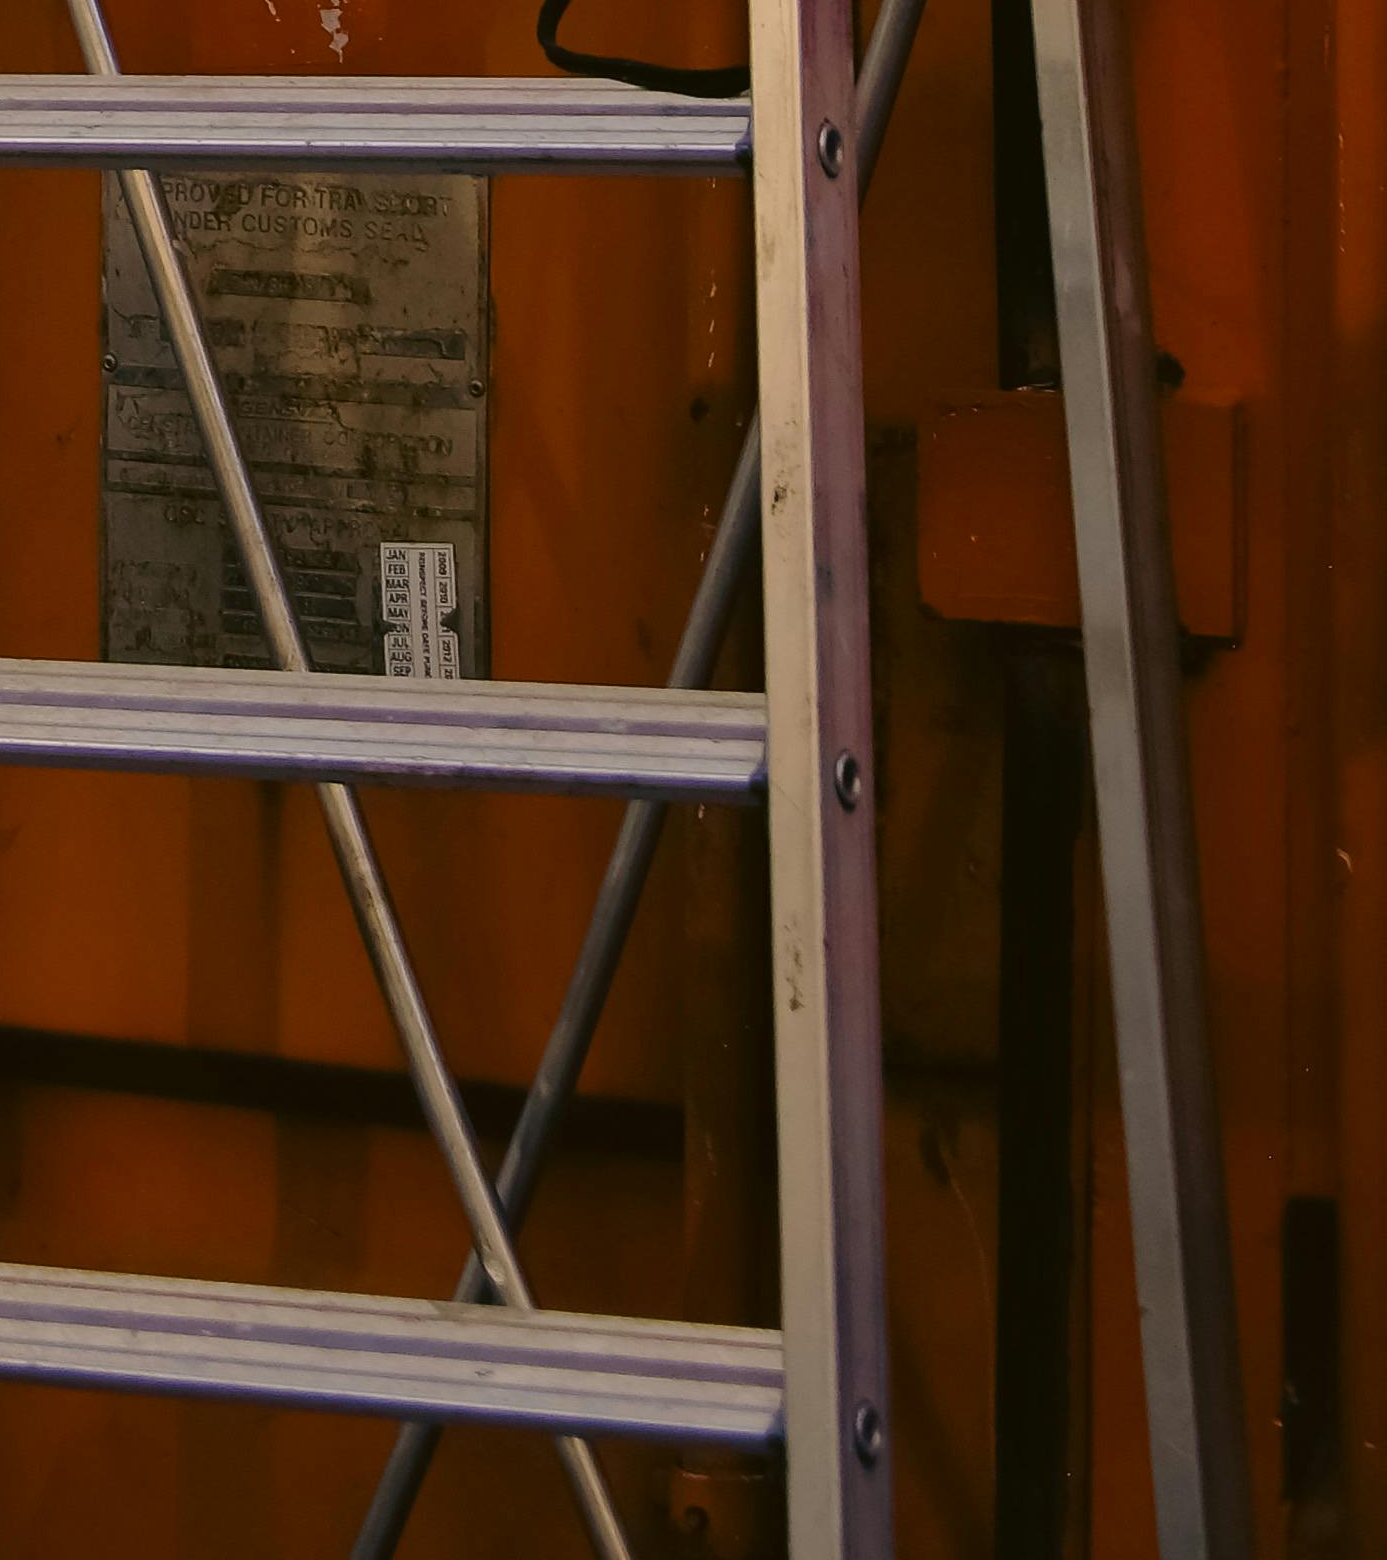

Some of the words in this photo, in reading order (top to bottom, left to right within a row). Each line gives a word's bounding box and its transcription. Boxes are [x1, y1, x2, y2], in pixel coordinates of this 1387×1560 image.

[260, 182, 308, 211] FOR
[386, 549, 407, 561] JAN
[388, 563, 406, 576] FEB
